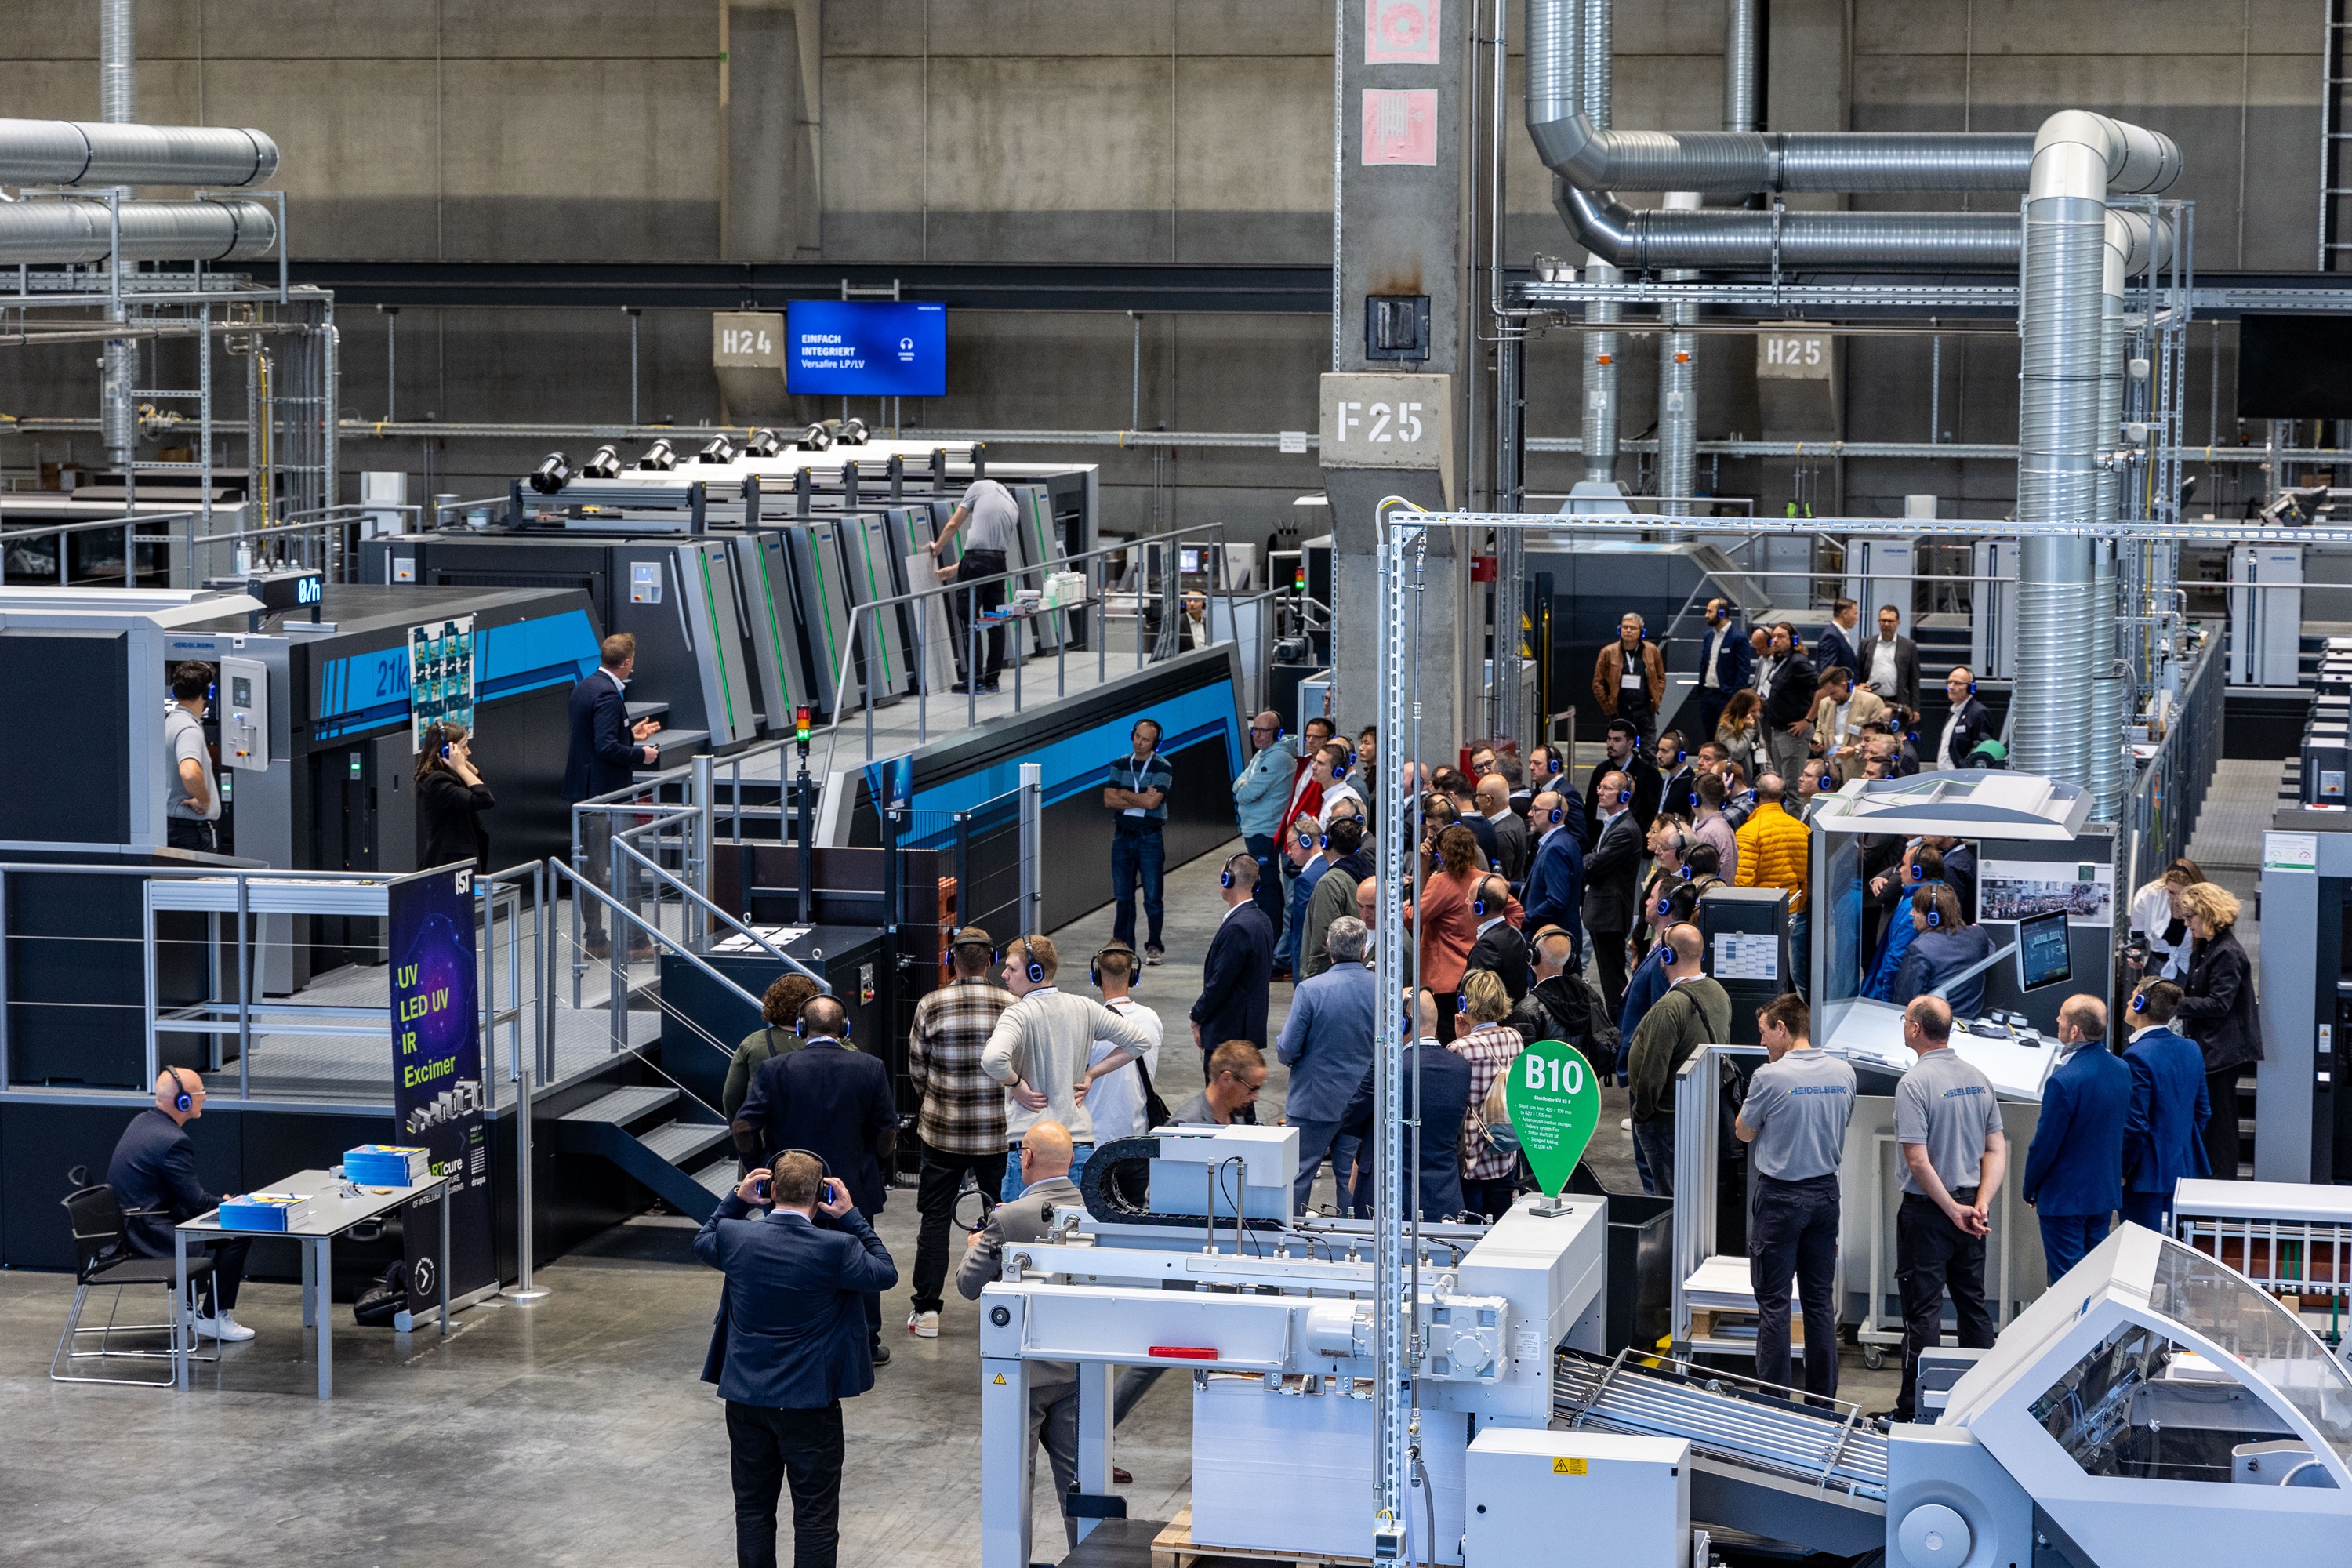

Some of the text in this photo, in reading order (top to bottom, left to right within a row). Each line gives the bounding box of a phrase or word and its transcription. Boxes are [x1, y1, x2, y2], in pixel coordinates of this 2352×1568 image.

[723, 329, 771, 354] H24
[801, 334, 841, 344] EINFACH
[801, 347, 855, 357] INTEGRIERT
[801, 359, 865, 369] Versafire LP/LV
[1767, 339, 1820, 365] H25
[1338, 401, 1422, 442] F25
[376, 654, 408, 697] 21k
[456, 869, 473, 895] IST
[398, 963, 418, 989] UV
[401, 987, 448, 1022] LED UV
[402, 1032, 417, 1054] IR
[404, 1056, 456, 1088] Excimer
[1526, 1054, 1583, 1094] B10
[1788, 1085, 1847, 1096] HEIDELBERG
[427, 1158, 463, 1176] RTcure
[471, 1176, 486, 1187] drupa
[412, 1200, 419, 1208] OF
